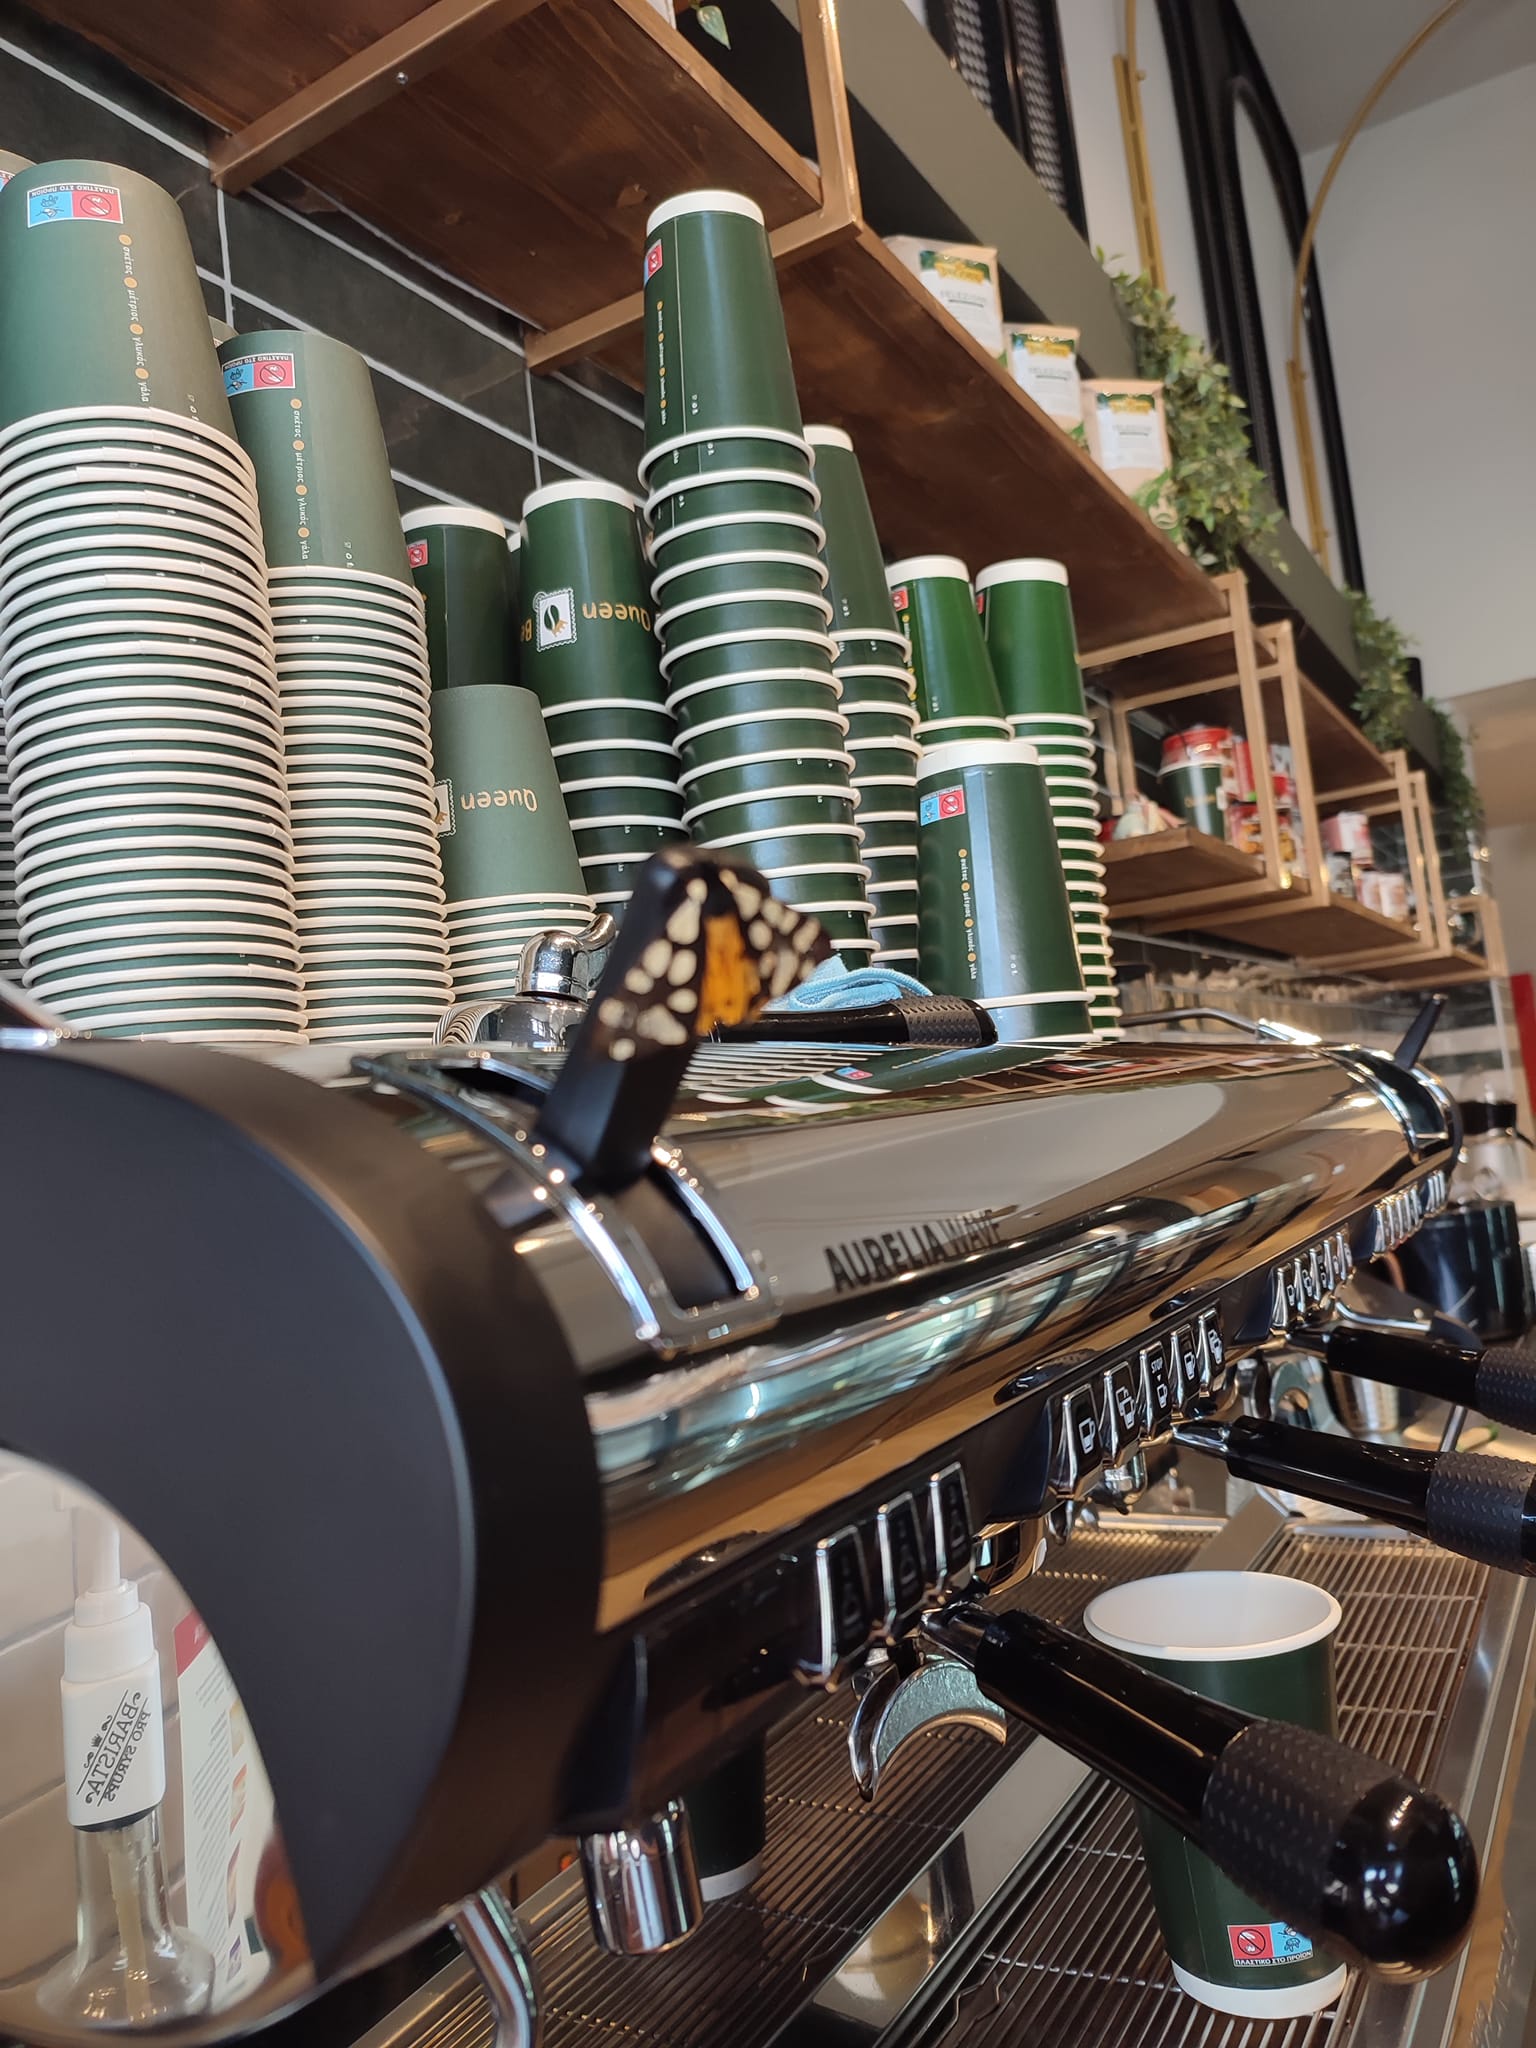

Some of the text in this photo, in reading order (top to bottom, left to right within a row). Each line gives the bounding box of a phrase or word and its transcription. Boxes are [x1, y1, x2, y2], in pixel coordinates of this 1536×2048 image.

[59, 184, 75, 192] ΣΤΟ
[76, 185, 114, 194] ΠΛΑΣΤΙΚΟ
[122, 246, 150, 402] σκέτος μέτριος γλυκός γάλα
[293, 410, 310, 560] σκέτος μέτριος γλυκός γάλα
[581, 601, 652, 632] Queen
[460, 788, 538, 813] Queen
[825, 1224, 944, 1292] AURELIA
[1235, 1958, 1271, 1966] ΠΛΑΣΤΙΚΟ
[1272, 1957, 1286, 1965] ΣΤΟ
